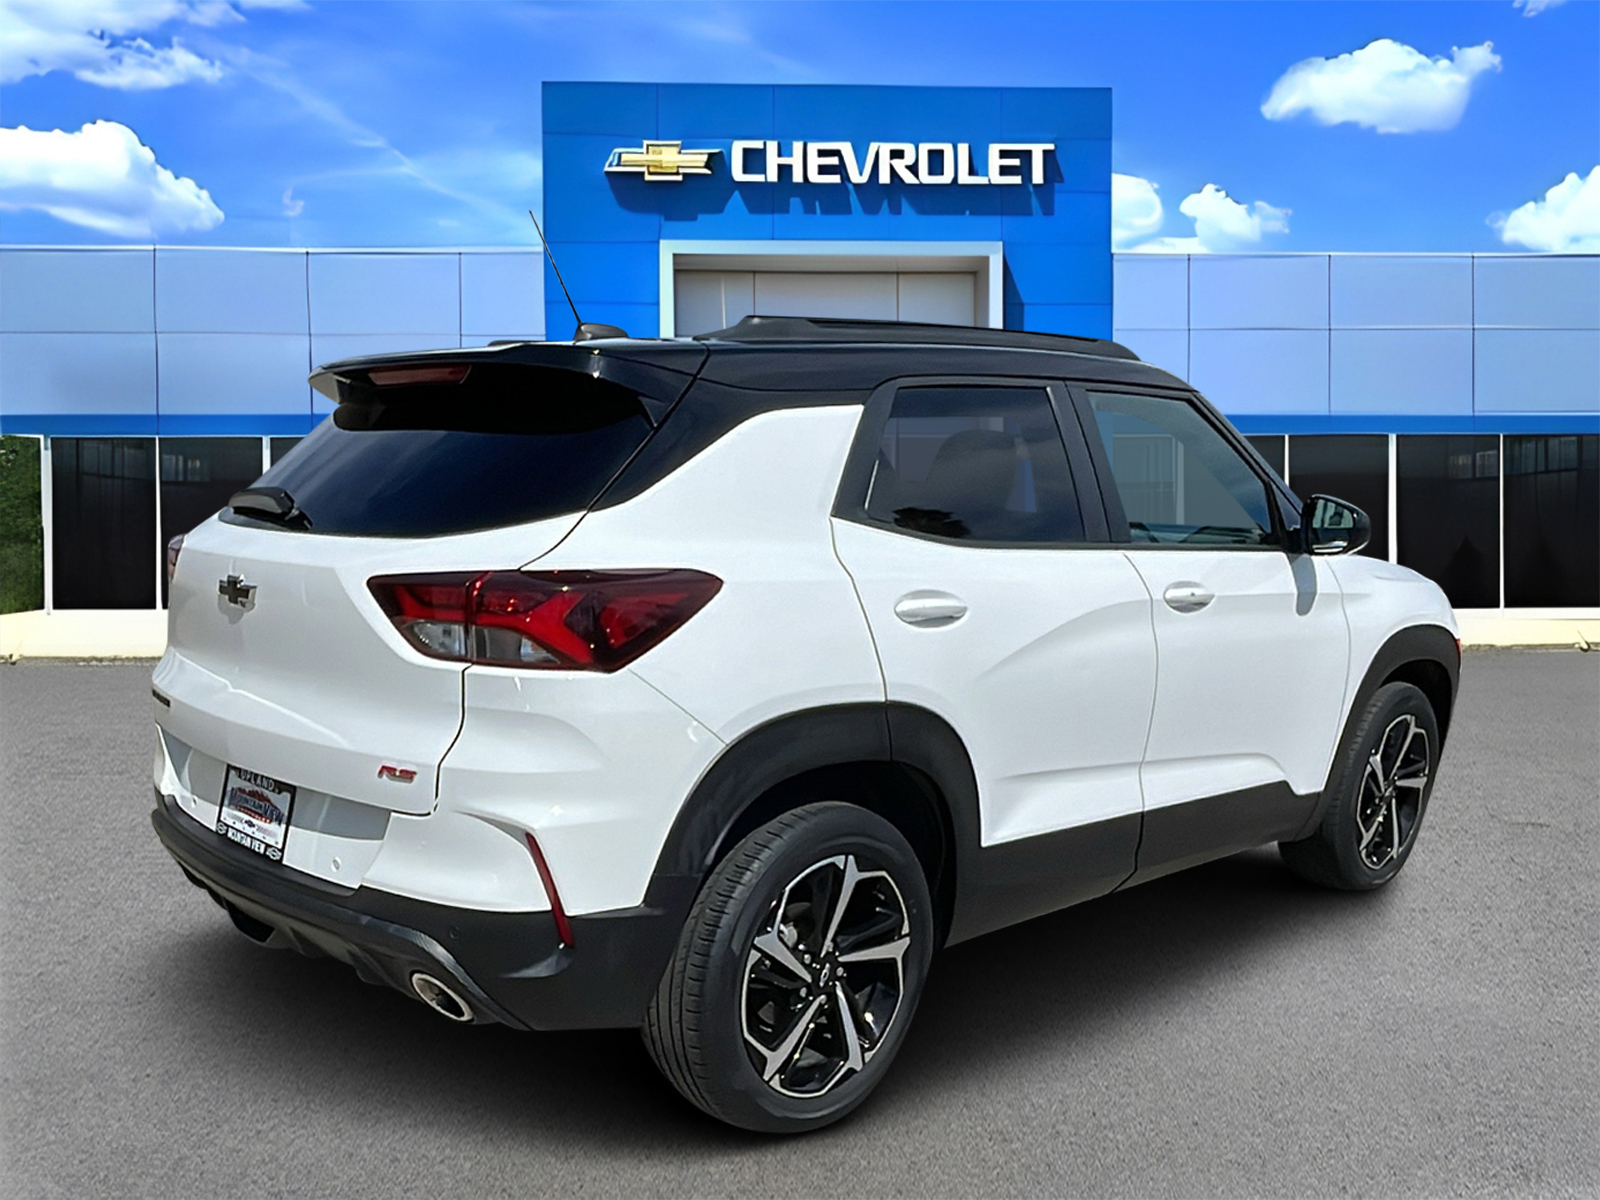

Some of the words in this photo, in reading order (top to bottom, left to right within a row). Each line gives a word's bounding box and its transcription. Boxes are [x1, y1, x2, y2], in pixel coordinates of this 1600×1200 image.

[731, 140, 1055, 185] CHEVROLET
[240, 768, 276, 790] UPLAND
[377, 765, 418, 784] RS
